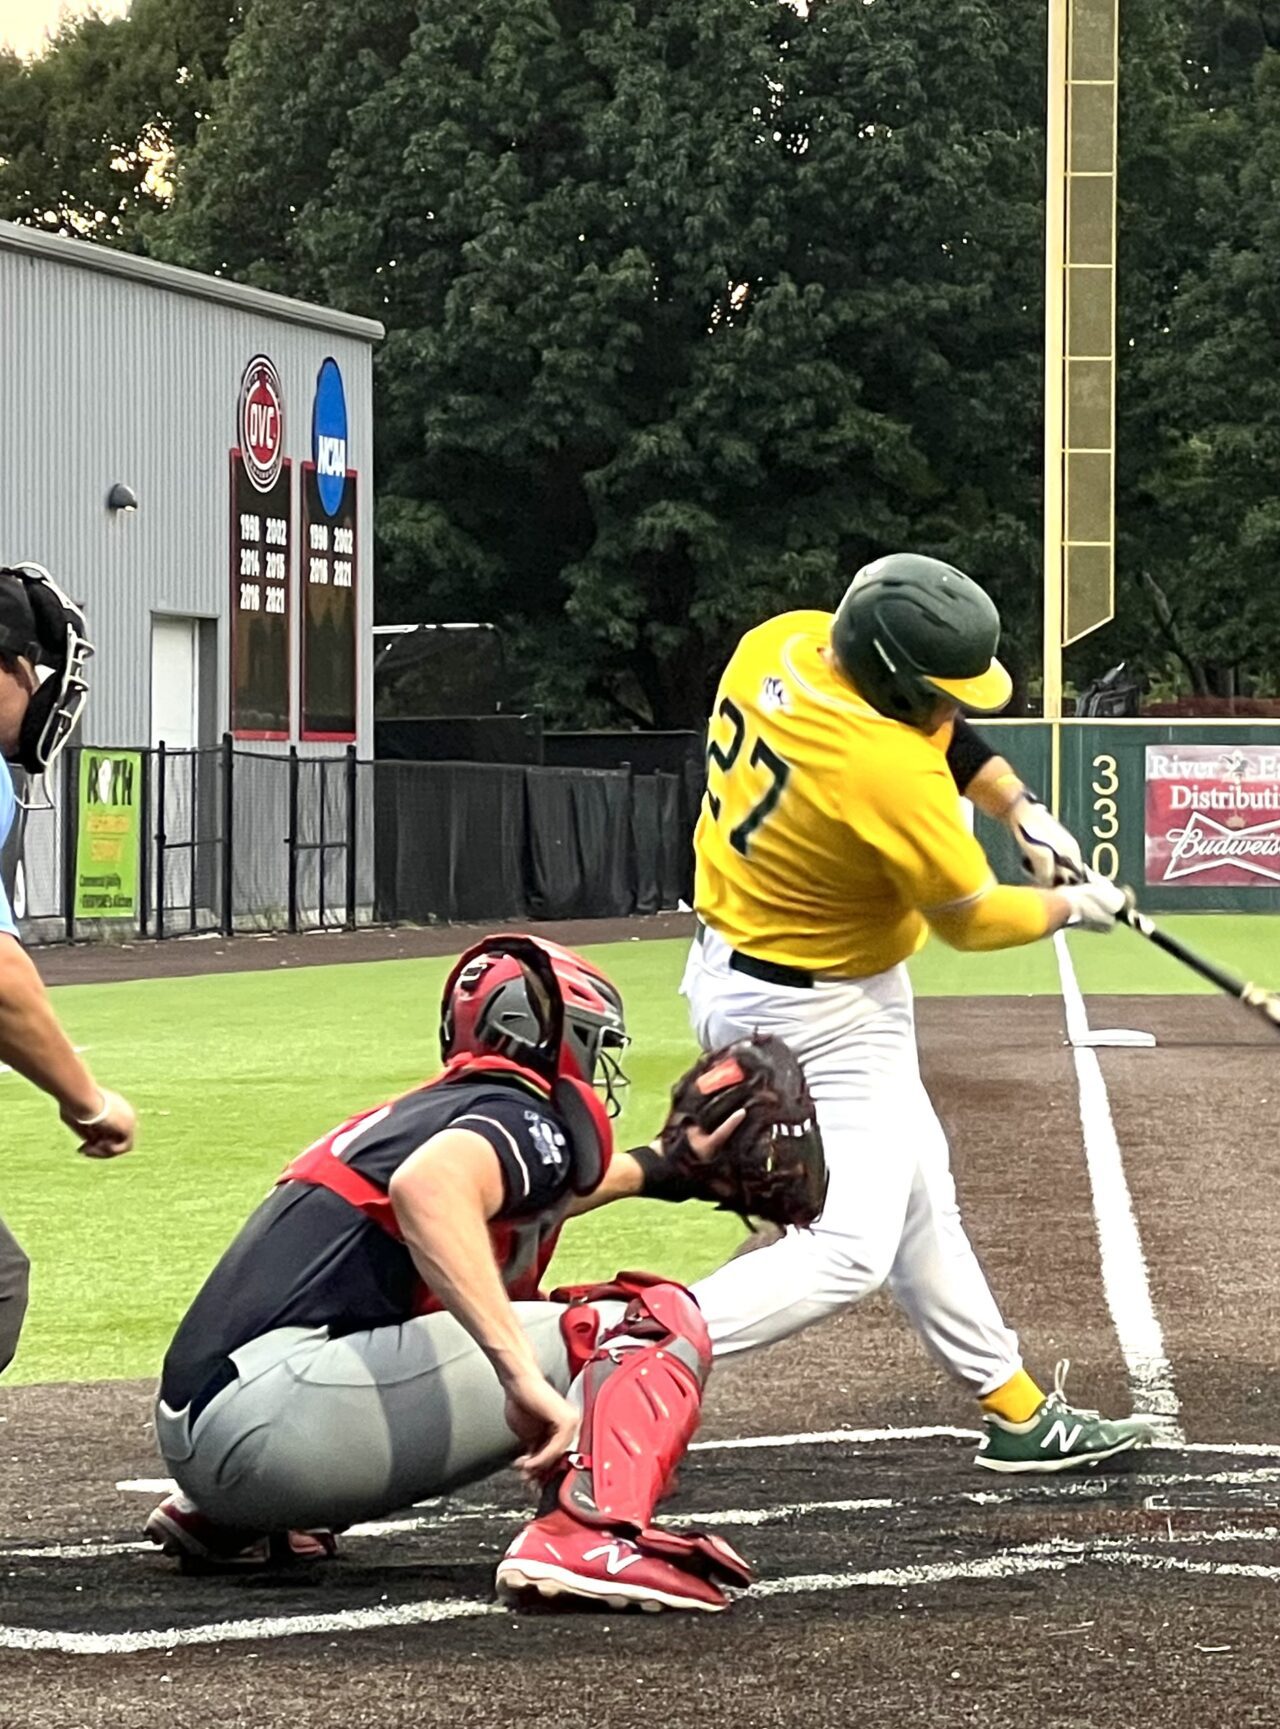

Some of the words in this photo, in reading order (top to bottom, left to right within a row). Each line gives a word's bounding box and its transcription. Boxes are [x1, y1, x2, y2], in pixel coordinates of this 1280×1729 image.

[250, 403, 275, 450] OVC
[317, 435, 345, 478] NCAA
[709, 697, 790, 858] 27
[1150, 755, 1220, 779] River
